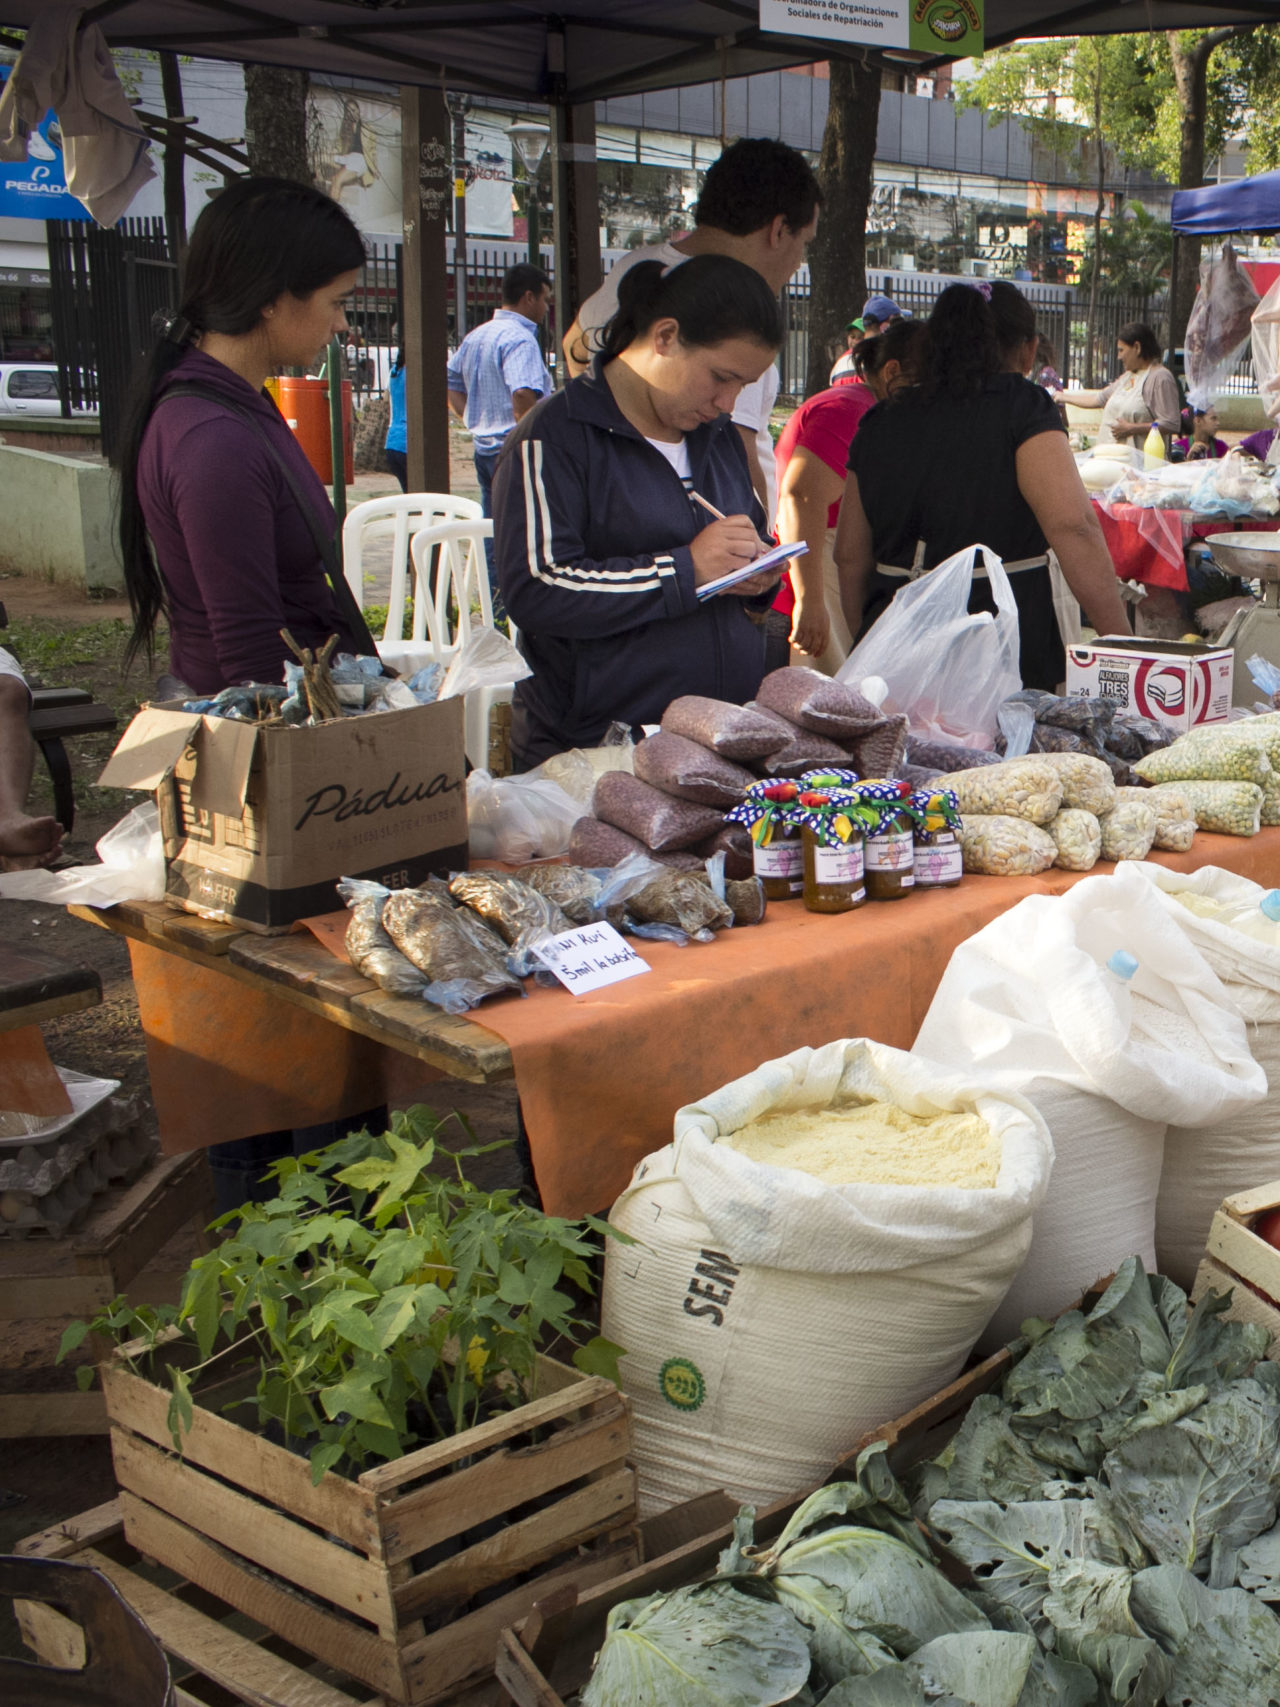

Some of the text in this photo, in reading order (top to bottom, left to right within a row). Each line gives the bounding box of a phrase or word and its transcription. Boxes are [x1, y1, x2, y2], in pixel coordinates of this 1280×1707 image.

[828, 0, 838, 9] de
[840, 3, 899, 18] Organizaciones
[787, 7, 884, 29] Sociales de Repatriación
[5, 180, 70, 194] PEGADA
[1100, 671, 1129, 682] ALFAJORES
[1080, 688, 1090, 697] 24
[1100, 681, 1128, 695] TRES
[199, 877, 238, 905] WAFER
